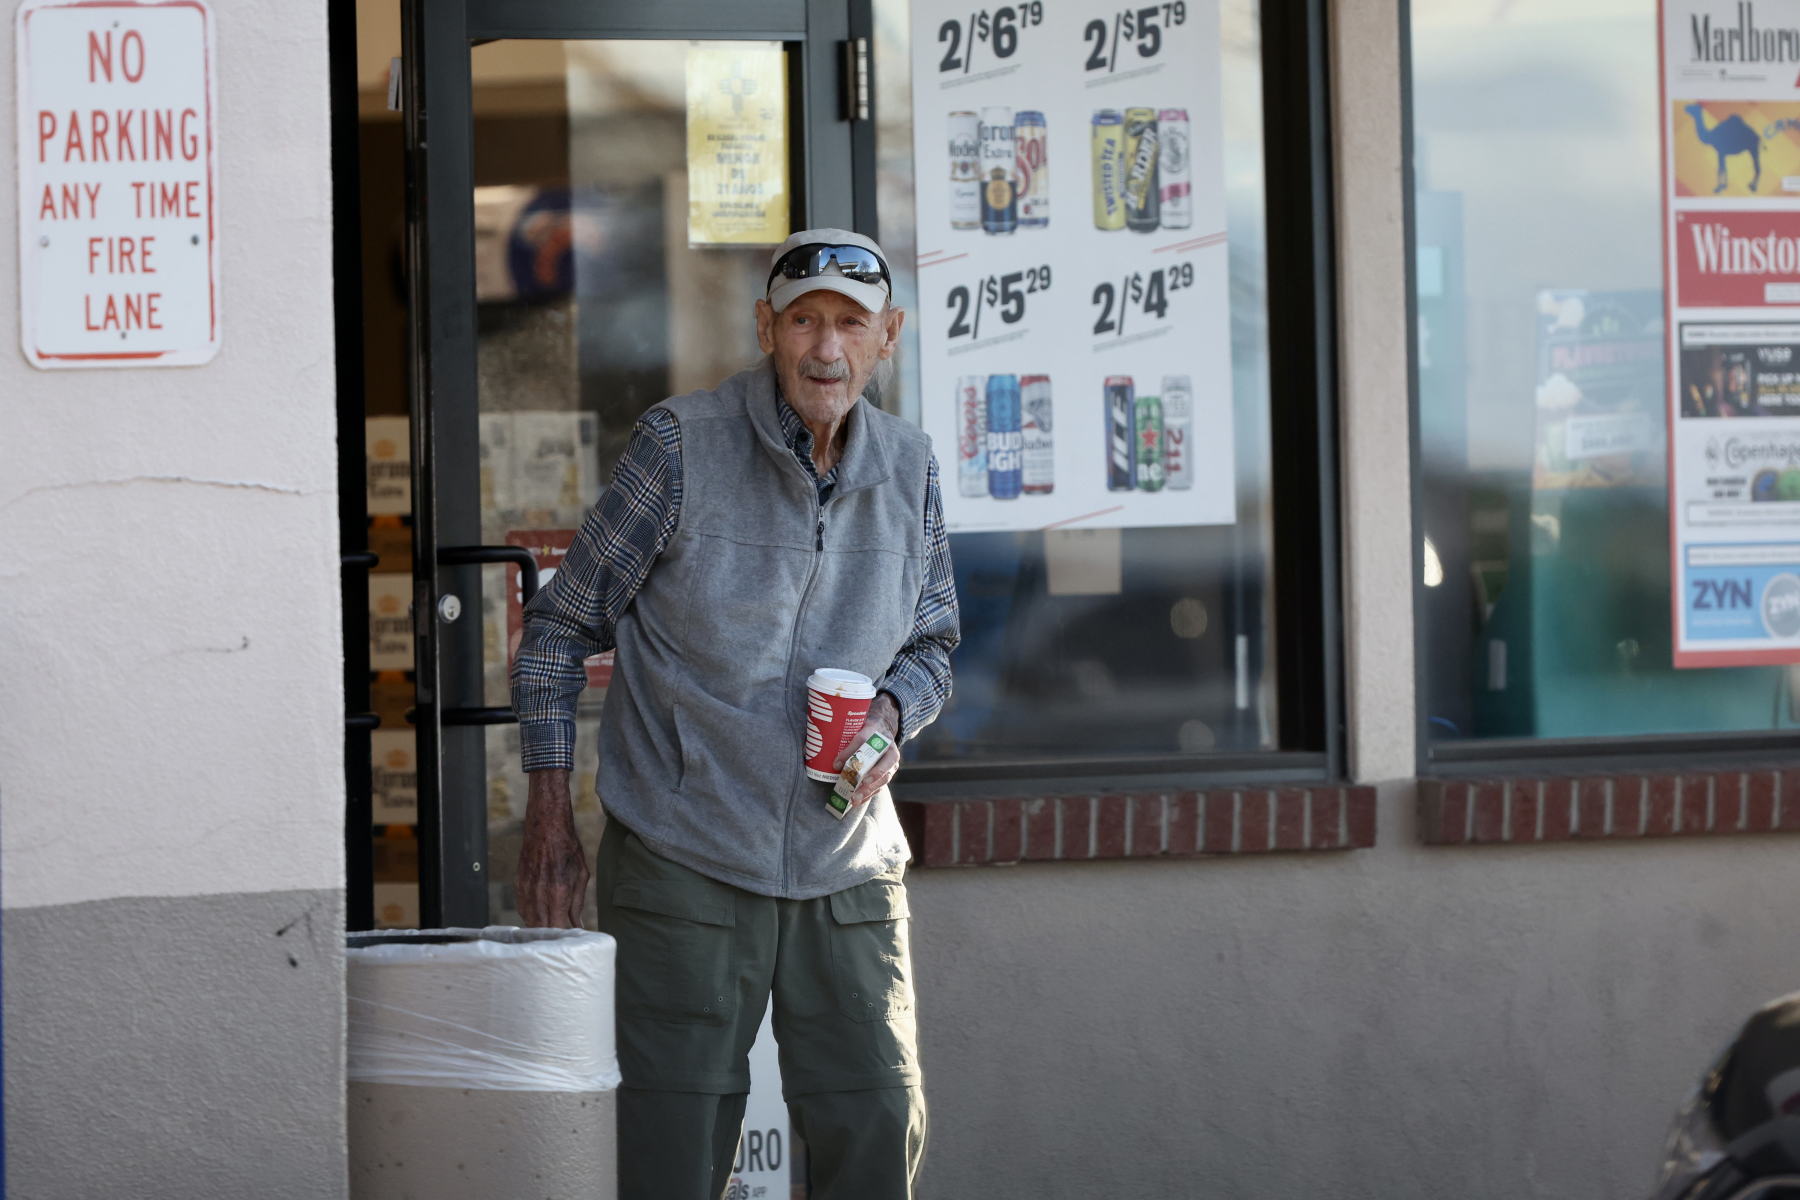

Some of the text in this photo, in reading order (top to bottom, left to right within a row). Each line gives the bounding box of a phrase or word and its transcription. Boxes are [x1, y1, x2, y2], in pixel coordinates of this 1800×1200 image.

[1691, 0, 1800, 63] Marlboro
[88, 30, 145, 83] NO
[39, 108, 199, 163] PARKING
[40, 181, 200, 220] ANY TIME
[89, 237, 156, 274] FIRE
[85, 293, 163, 331] LANE
[987, 432, 1021, 451] BUD
[1724, 437, 1800, 468] Copenhag
[988, 451, 1021, 472] IGH
[1691, 577, 1753, 610] ZYN
